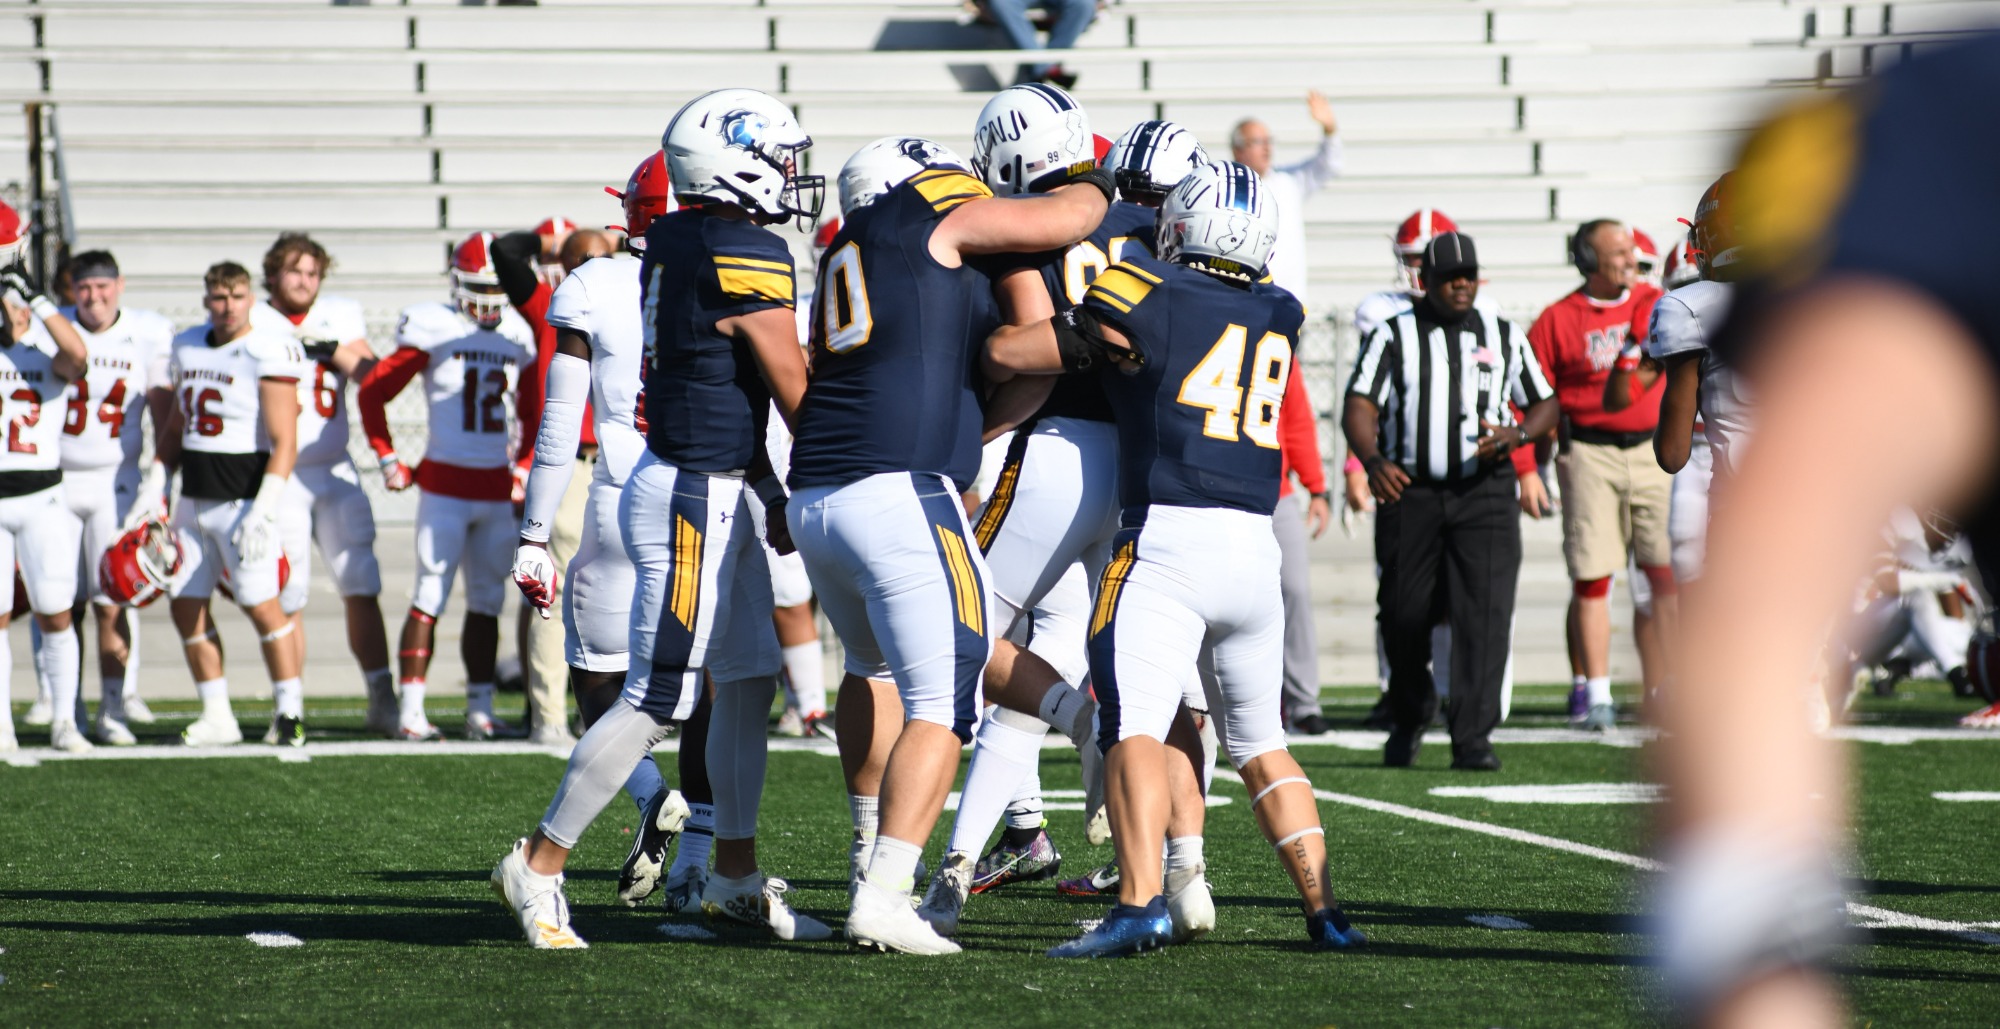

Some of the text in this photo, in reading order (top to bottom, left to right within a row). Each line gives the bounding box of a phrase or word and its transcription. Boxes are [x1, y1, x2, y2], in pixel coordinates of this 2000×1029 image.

[1047, 150, 1060, 163] 99
[1067, 160, 1095, 176] LIONS
[1209, 257, 1241, 273] LIONS
[463, 367, 508, 433] 12
[1177, 323, 1292, 449] 48
[183, 386, 224, 437] 16
